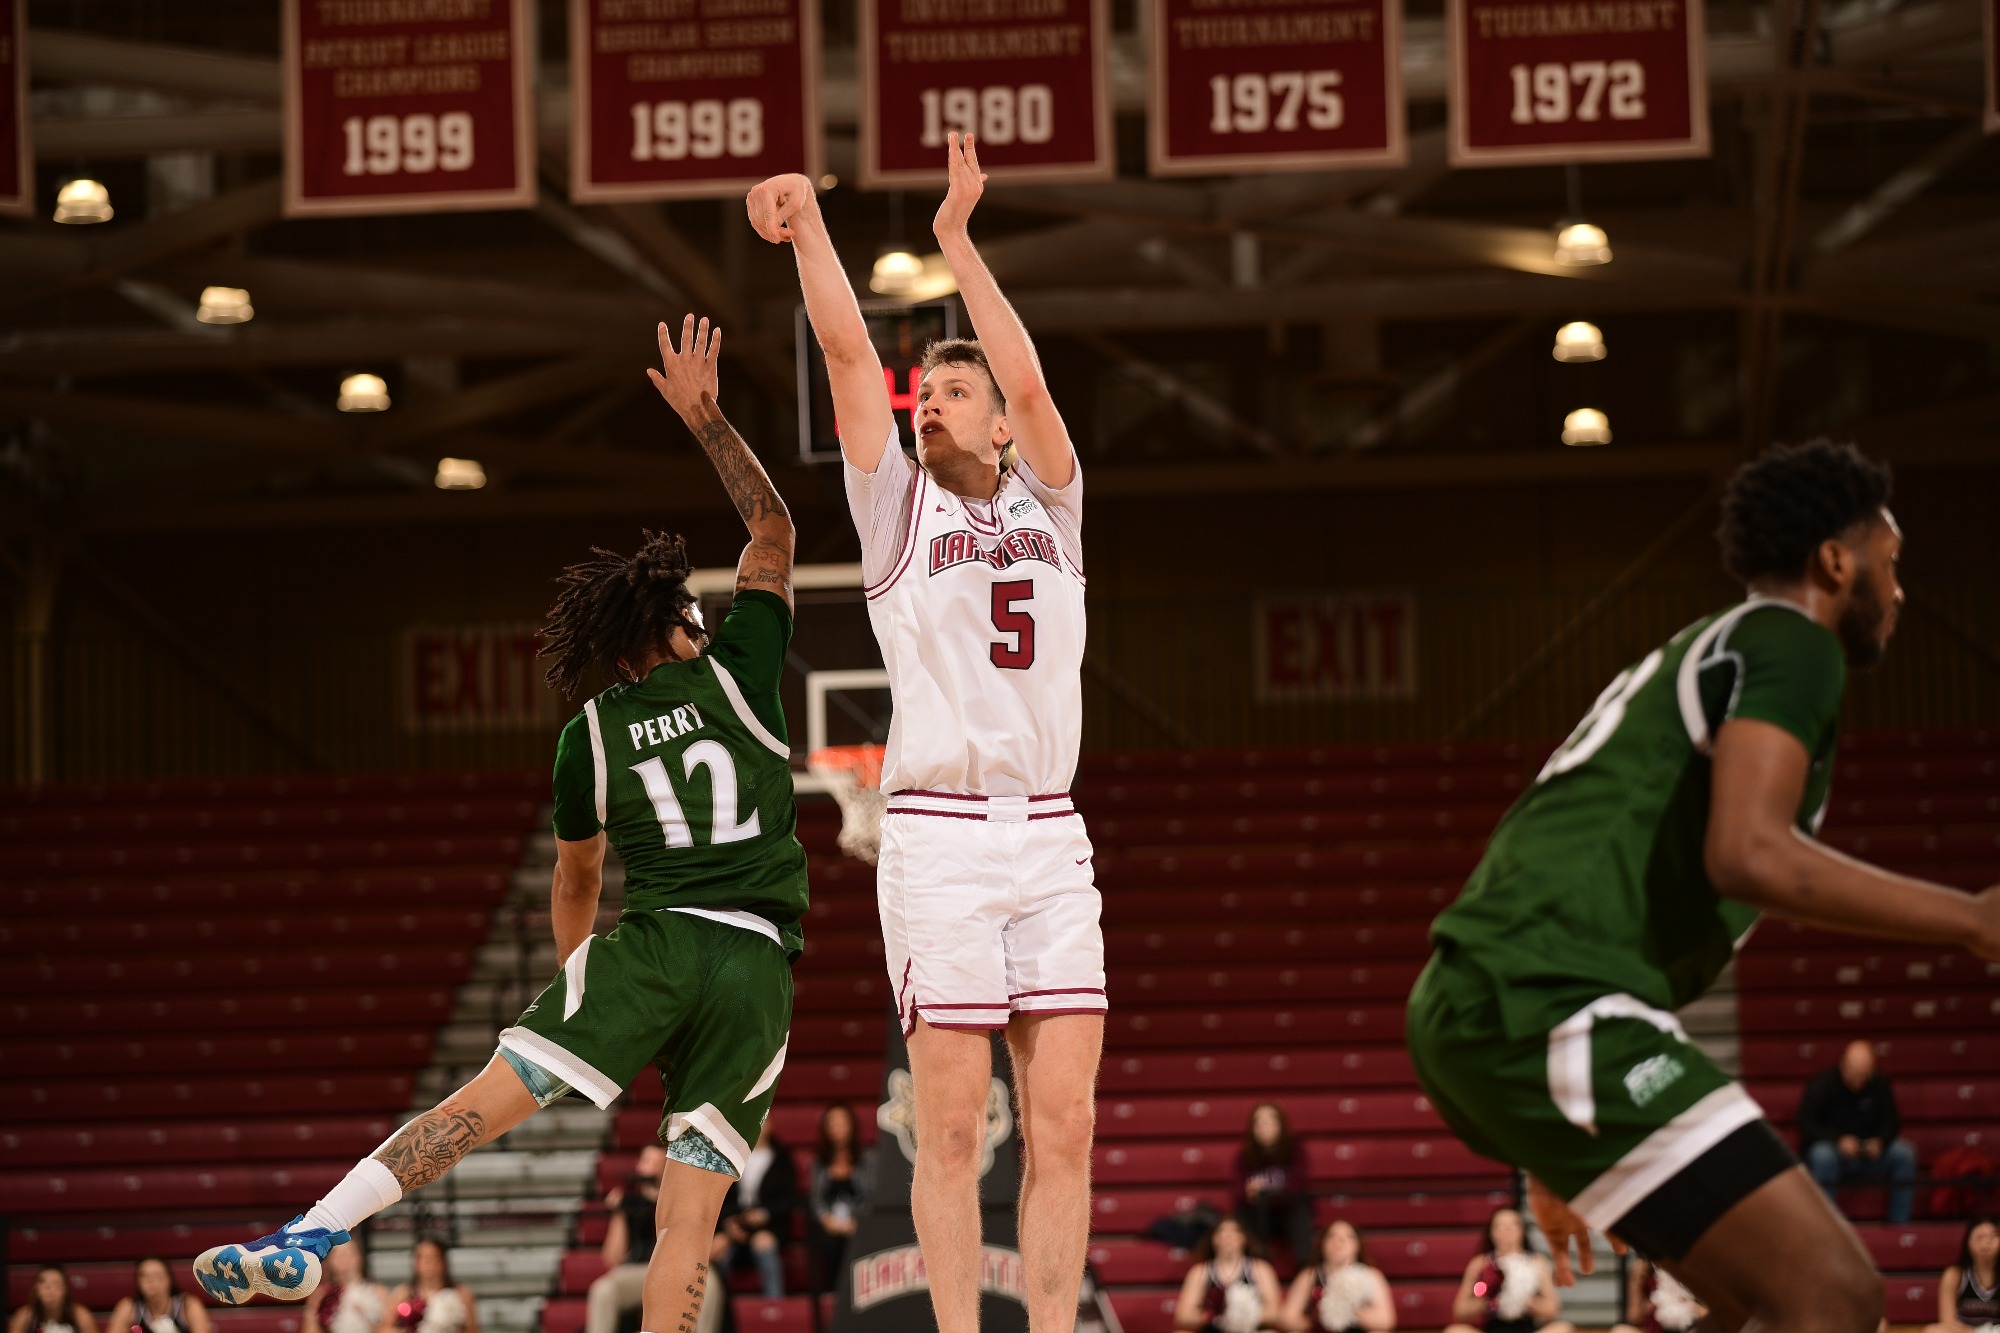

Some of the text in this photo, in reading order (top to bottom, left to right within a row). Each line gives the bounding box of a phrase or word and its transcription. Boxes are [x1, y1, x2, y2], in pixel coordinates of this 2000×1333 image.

[304, 31, 509, 67] PATRIOT LEAGUE
[886, 25, 1084, 63] TOURNAMENT
[1172, 8, 1378, 50] TOURNAMENT
[1473, 0, 1679, 39] TOURNAMENT
[334, 64, 481, 97] CHAMPIONS
[627, 50, 764, 82] CHAMPIONS
[1509, 59, 1646, 124] 1972
[630, 99, 764, 162] 1998
[920, 85, 1053, 147] 1980
[1209, 70, 1344, 134] 1975
[342, 112, 474, 176] 1999
[930, 529, 1062, 575] LAFYETTE
[990, 579, 1035, 670] 5
[1268, 601, 1404, 686] EXIT
[412, 631, 543, 714] EXIT
[628, 703, 705, 751] PERRY
[629, 740, 762, 850] 12
